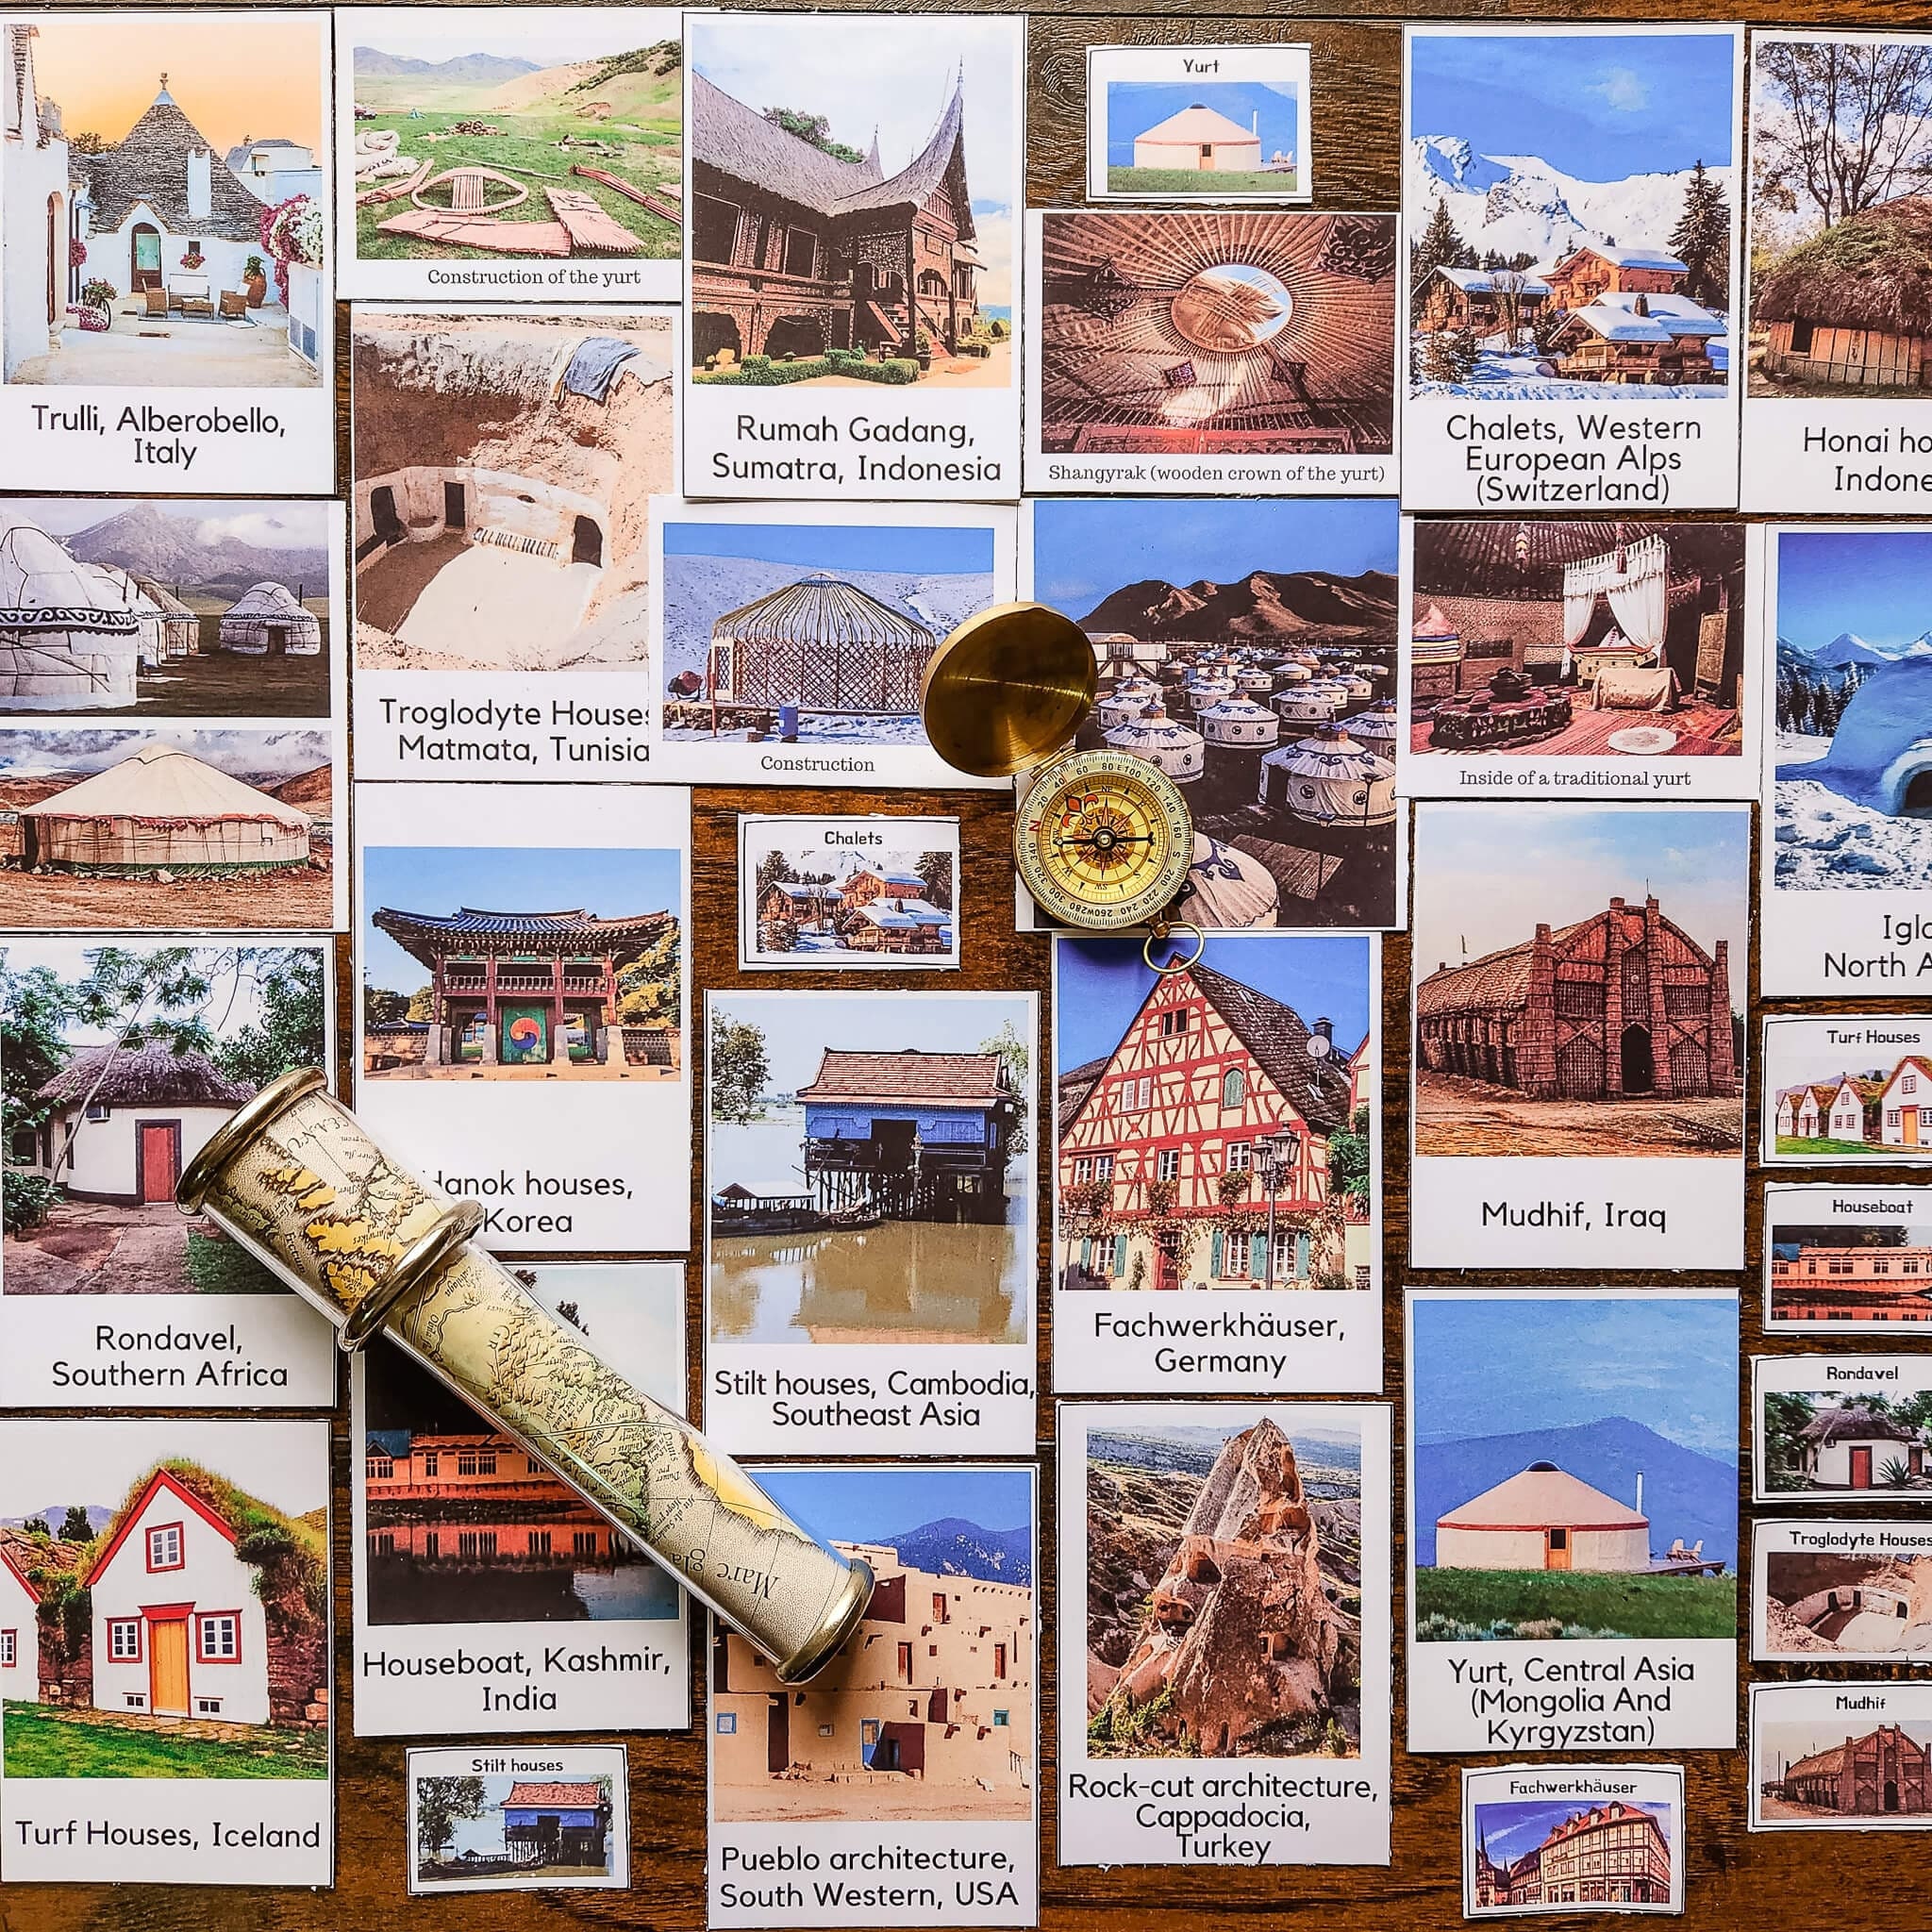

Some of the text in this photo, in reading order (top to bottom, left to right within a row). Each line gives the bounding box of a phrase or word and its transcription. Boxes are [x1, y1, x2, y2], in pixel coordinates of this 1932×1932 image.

[1183, 58, 1218, 74] Yurt
[427, 269, 641, 289] Construction of the yurt
[31, 404, 287, 440] Trulli, Alberobello,
[737, 414, 974, 449] Rumah Gadang,
[1446, 413, 1701, 445] Chalets, Western
[134, 437, 198, 471] Italy
[1804, 426, 1890, 453] Honai
[712, 452, 1001, 485] Sumatra, Indonesia
[1048, 464, 1385, 485] Shangyrak (wooden crown of the yurt)
[1466, 444, 1682, 479] European Alps
[1475, 475, 1670, 507] (Switzerland)
[378, 698, 650, 730] Troglodyte House
[399, 734, 650, 765] Matmata, Tunisia
[760, 755, 875, 772] Construction
[1459, 770, 1691, 790] Inside of a traditional yurt
[824, 830, 883, 845] Chalets
[1824, 951, 1907, 978] North
[1825, 1029, 1921, 1044] Turf Houses
[525, 1169, 633, 1200] houses,
[483, 1208, 573, 1233] Korea
[1482, 1201, 1666, 1234] Mudhif, Iraq
[1832, 1199, 1914, 1214] Houseboat
[96, 1324, 242, 1355] Rondavel,
[1095, 1311, 1344, 1341] Fachwerkhäuser,
[52, 1359, 288, 1387] Southern Africa
[1155, 1347, 1288, 1379] Germany
[1826, 1365, 1899, 1380] Rondavel
[714, 1367, 1040, 1401] Stilt houses, Cambodia,
[772, 1400, 980, 1426] Southeast Asia
[1789, 1530, 1932, 1551] Troglodyte Houses
[363, 1645, 671, 1677] Houseboat, Kashmir,
[1447, 1656, 1694, 1689] Yurt, Central Asia
[482, 1684, 557, 1712] India
[1471, 1686, 1671, 1721] (Mongolia And
[1836, 1695, 1886, 1710] Mudhif
[1487, 1716, 1656, 1747] Kyrgyzstan)
[472, 1757, 564, 1773] Stilt houses
[1069, 1772, 1378, 1803] Rock-cut architecture,
[1509, 1778, 1639, 1795] Fachwerkhäuser
[1136, 1802, 1311, 1836] Cappadocia,
[14, 1820, 320, 1851] Turf Houses, Iceland
[1176, 1834, 1271, 1864] Turkey
[722, 1844, 1015, 1874] Pueblo architecture,
[720, 1881, 1020, 1910] South Western, USA
